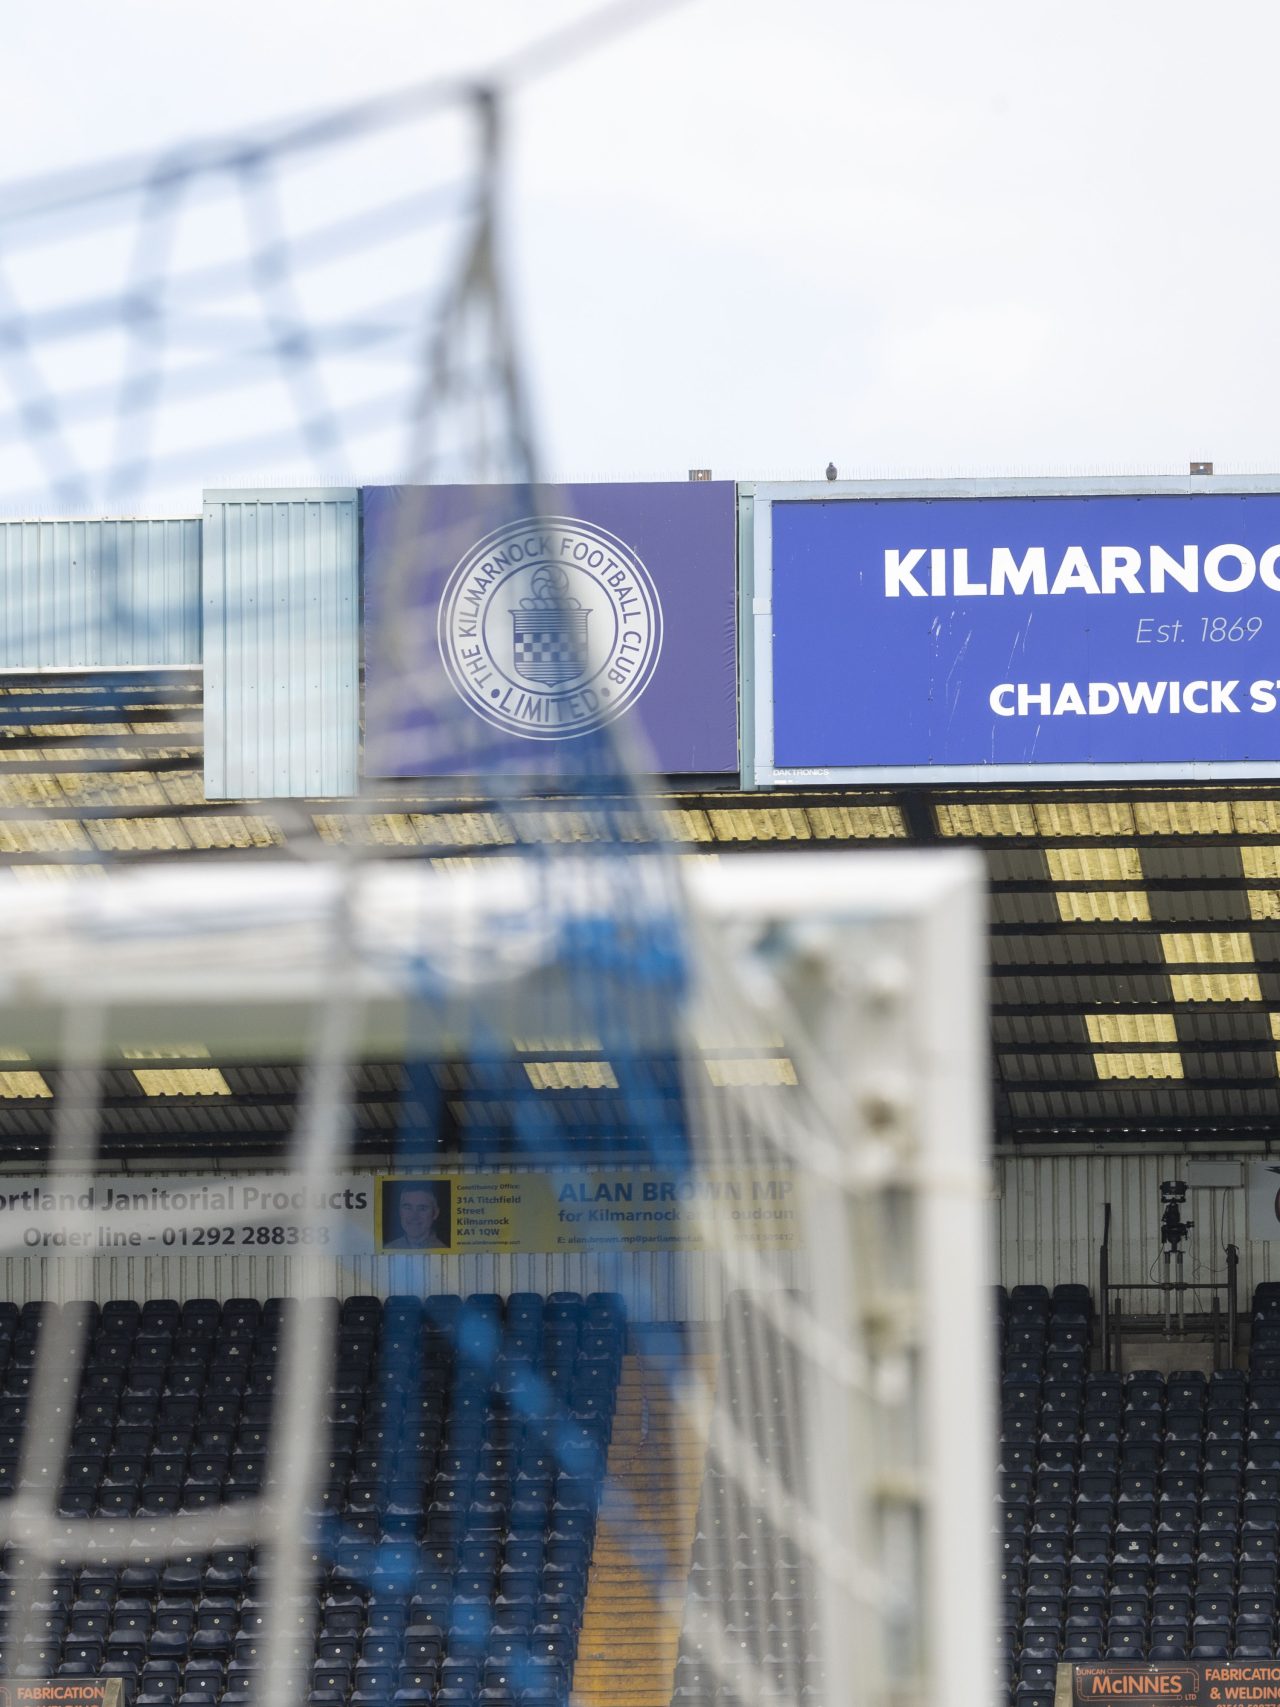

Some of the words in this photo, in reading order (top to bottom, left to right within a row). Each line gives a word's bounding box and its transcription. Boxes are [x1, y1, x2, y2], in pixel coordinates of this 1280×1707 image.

[458, 536, 553, 638] KILMARNOCK
[560, 538, 642, 624] FOOTBALL
[1135, 618, 1186, 645] Est.
[1200, 615, 1264, 644] 1869
[461, 645, 492, 689] THE
[607, 630, 642, 685] CLUB
[498, 687, 600, 723] LIMITED
[988, 681, 1240, 718] CHADWICK
[773, 768, 830, 776] DAKTRONICS
[101, 1186, 234, 1212] Janitorial
[243, 1186, 367, 1210] Products
[457, 1196, 474, 1204] 31A
[478, 1195, 521, 1204] Titchfield
[558, 1182, 633, 1203] ALAN
[752, 1180, 794, 1201] MP
[457, 1207, 484, 1215] Street
[457, 1217, 510, 1226] Kilmarnock
[558, 1209, 583, 1222] for
[588, 1208, 681, 1222] Kilmarnock
[23, 1226, 92, 1247] Order
[98, 1226, 141, 1247] line
[162, 1226, 235, 1246] 01292
[457, 1228, 475, 1236] KA1
[479, 1228, 500, 1236] 1QW
[16, 1687, 105, 1700] FABRICATION
[1091, 1675, 1183, 1694] McINNES
[1209, 1688, 1221, 1700] &
